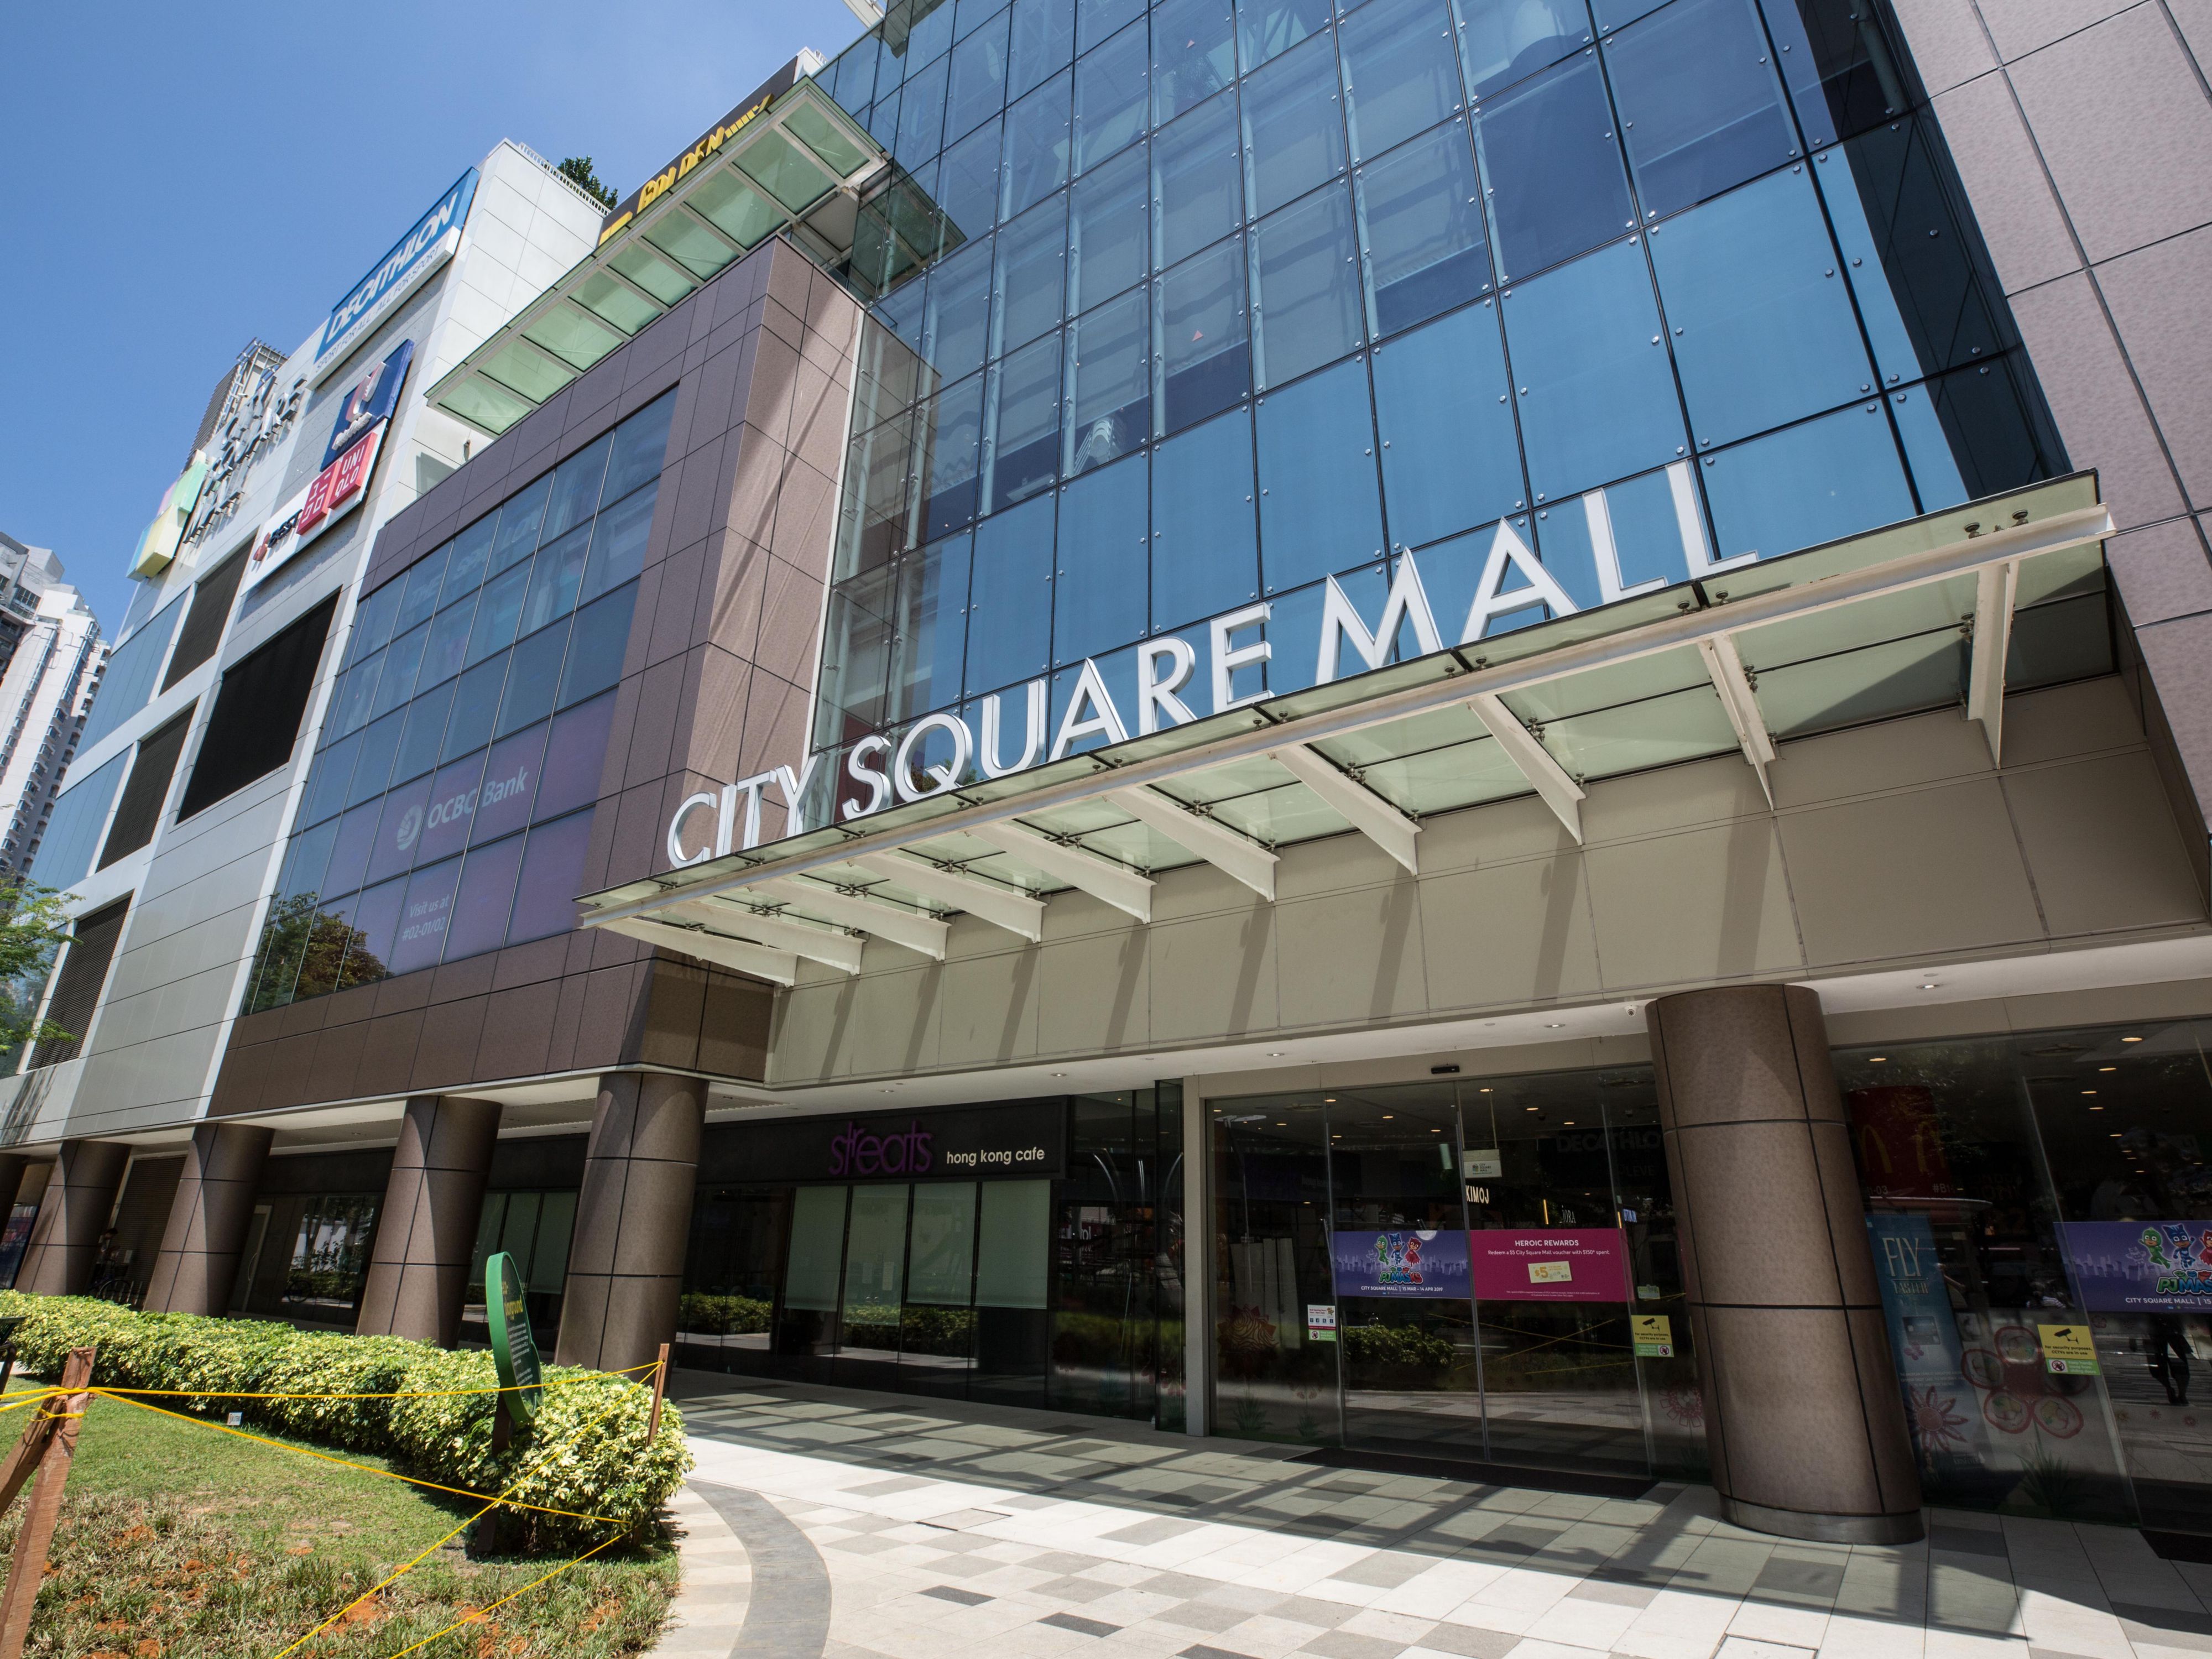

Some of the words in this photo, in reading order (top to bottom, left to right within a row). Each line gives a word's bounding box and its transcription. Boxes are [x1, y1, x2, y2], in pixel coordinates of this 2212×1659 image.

[325, 191, 458, 343] DECATHLON
[342, 444, 365, 475] UNI
[335, 466, 359, 497] QLO
[667, 753, 826, 869] CITY
[842, 603, 1275, 820] SQUARE
[1315, 460, 1758, 686] MALL
[427, 789, 478, 828] OCBC
[482, 766, 529, 807] Bank
[409, 900, 427, 918] Visit
[429, 901, 440, 911] us
[440, 894, 450, 909] at
[403, 916, 446, 942] #02-01/02
[828, 1120, 934, 1175] streats
[947, 1151, 977, 1166] hong
[980, 1149, 1011, 1165] kong
[1015, 1146, 1045, 1161] cafe
[1558, 1130, 1662, 1152] DECATHLO
[1882, 1238, 1922, 1277] FLY
